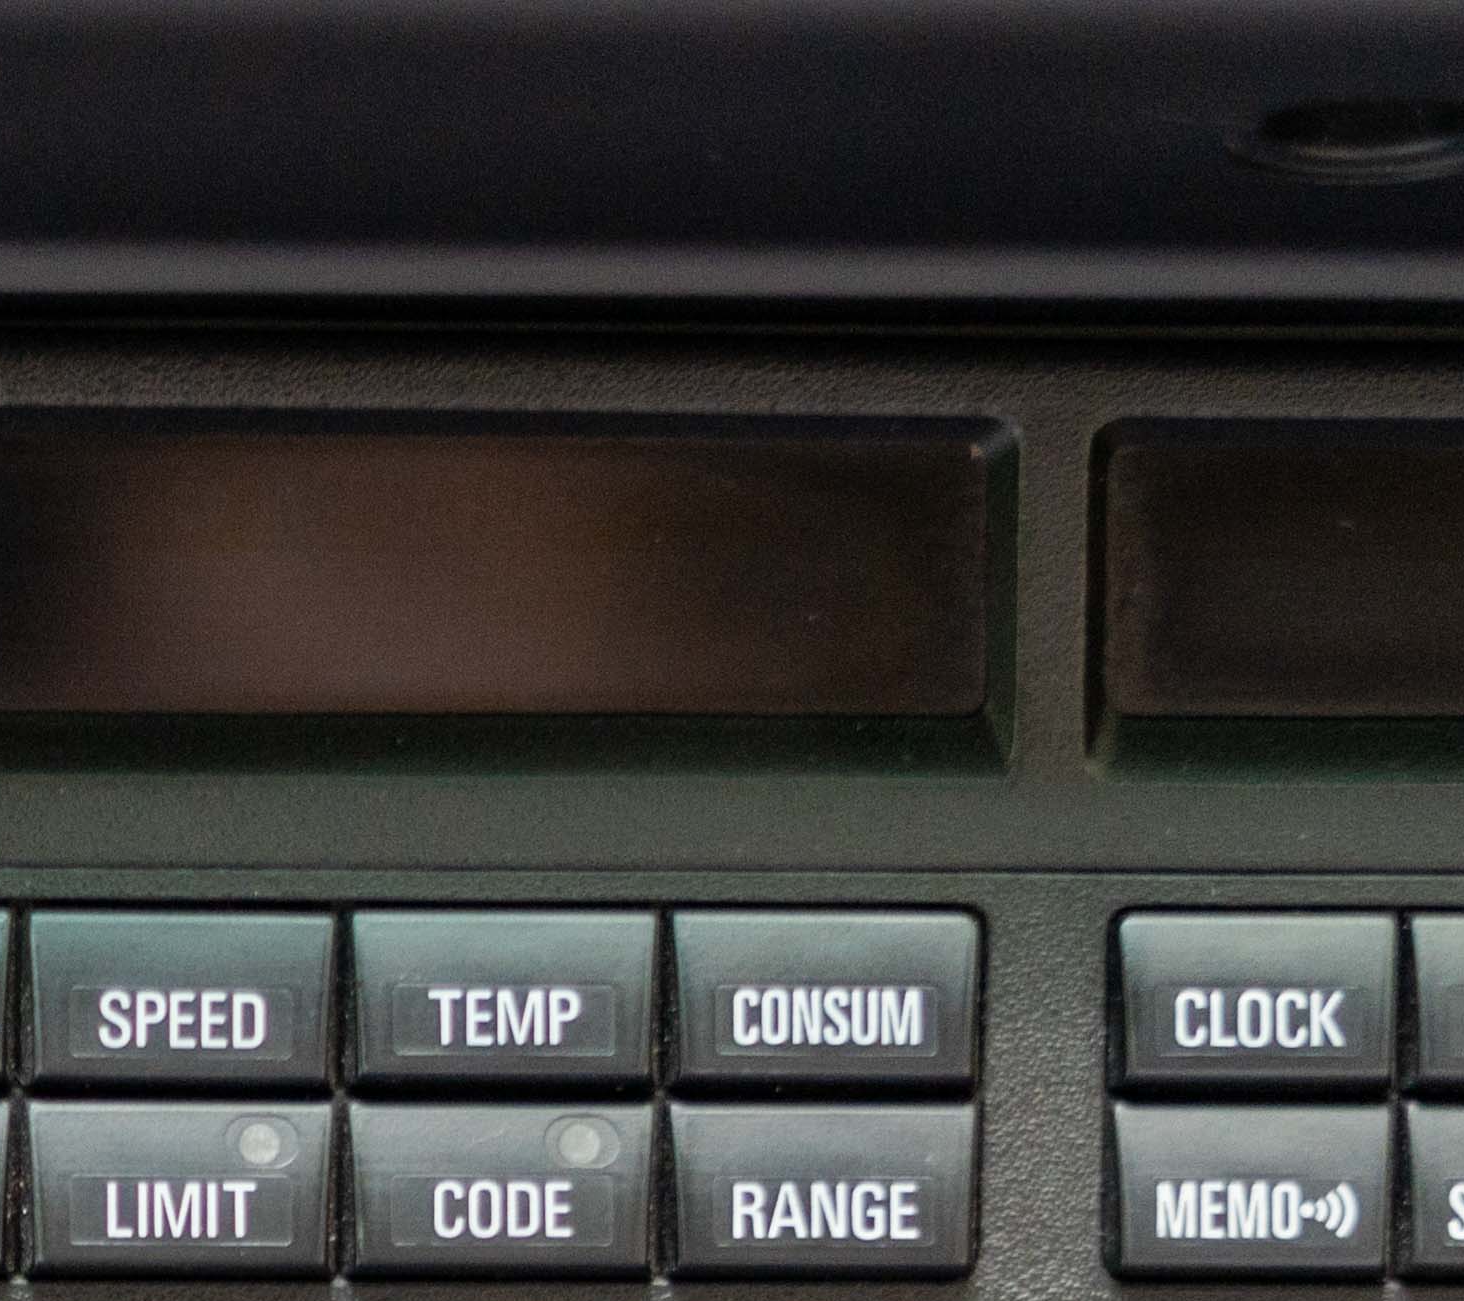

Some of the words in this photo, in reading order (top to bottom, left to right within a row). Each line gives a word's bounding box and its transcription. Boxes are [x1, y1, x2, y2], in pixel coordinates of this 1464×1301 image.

[97, 987, 268, 1051] SPEED
[428, 986, 582, 1047] TEMP
[731, 985, 923, 1047] CONSUM
[1173, 987, 1346, 1050] CLOCK
[106, 1179, 257, 1240] LIMIT
[432, 1178, 574, 1240] CODE
[731, 1180, 921, 1242] RANGE
[1154, 1180, 1300, 1241] MEMO
